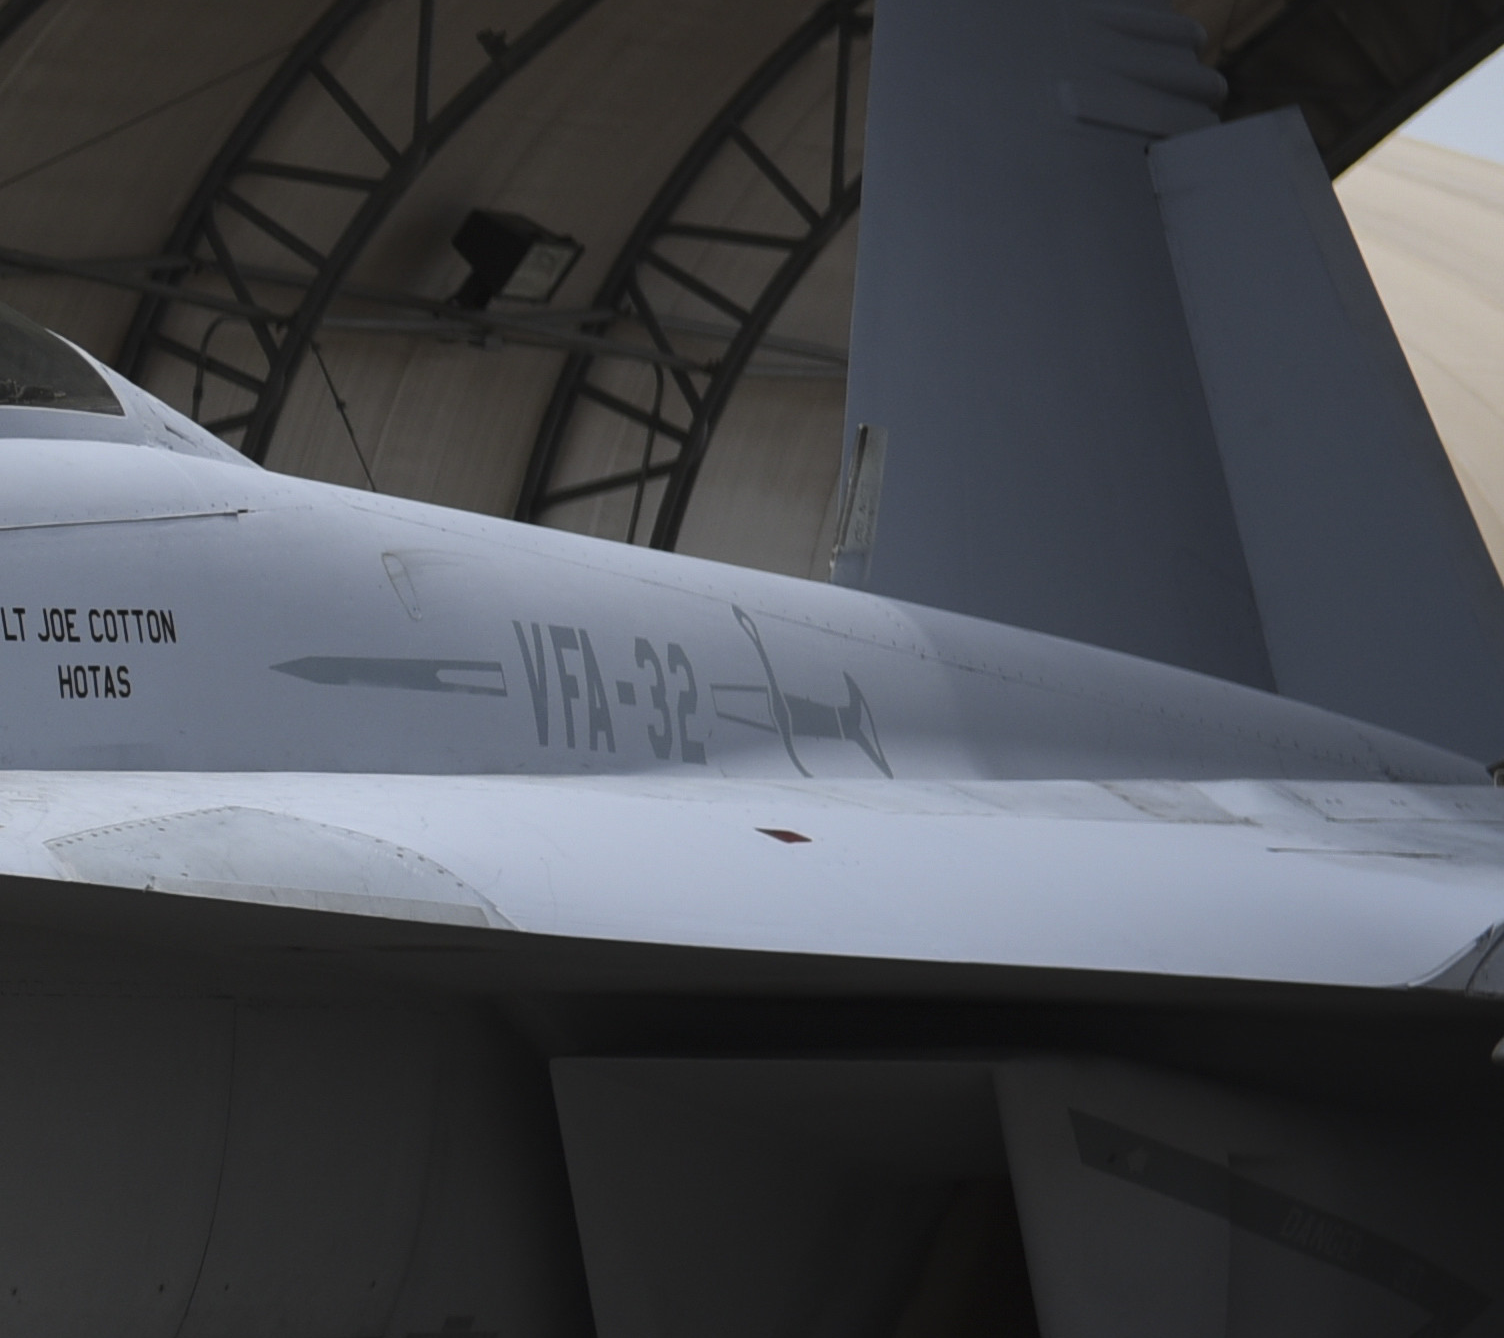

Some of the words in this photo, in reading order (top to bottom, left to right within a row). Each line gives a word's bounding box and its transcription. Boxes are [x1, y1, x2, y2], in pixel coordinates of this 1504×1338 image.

[0, 606, 26, 642] LT
[37, 607, 81, 643] JOE
[88, 608, 177, 644] COTTON
[57, 664, 132, 700] HOTAS
[511, 619, 707, 766] VFA-32
